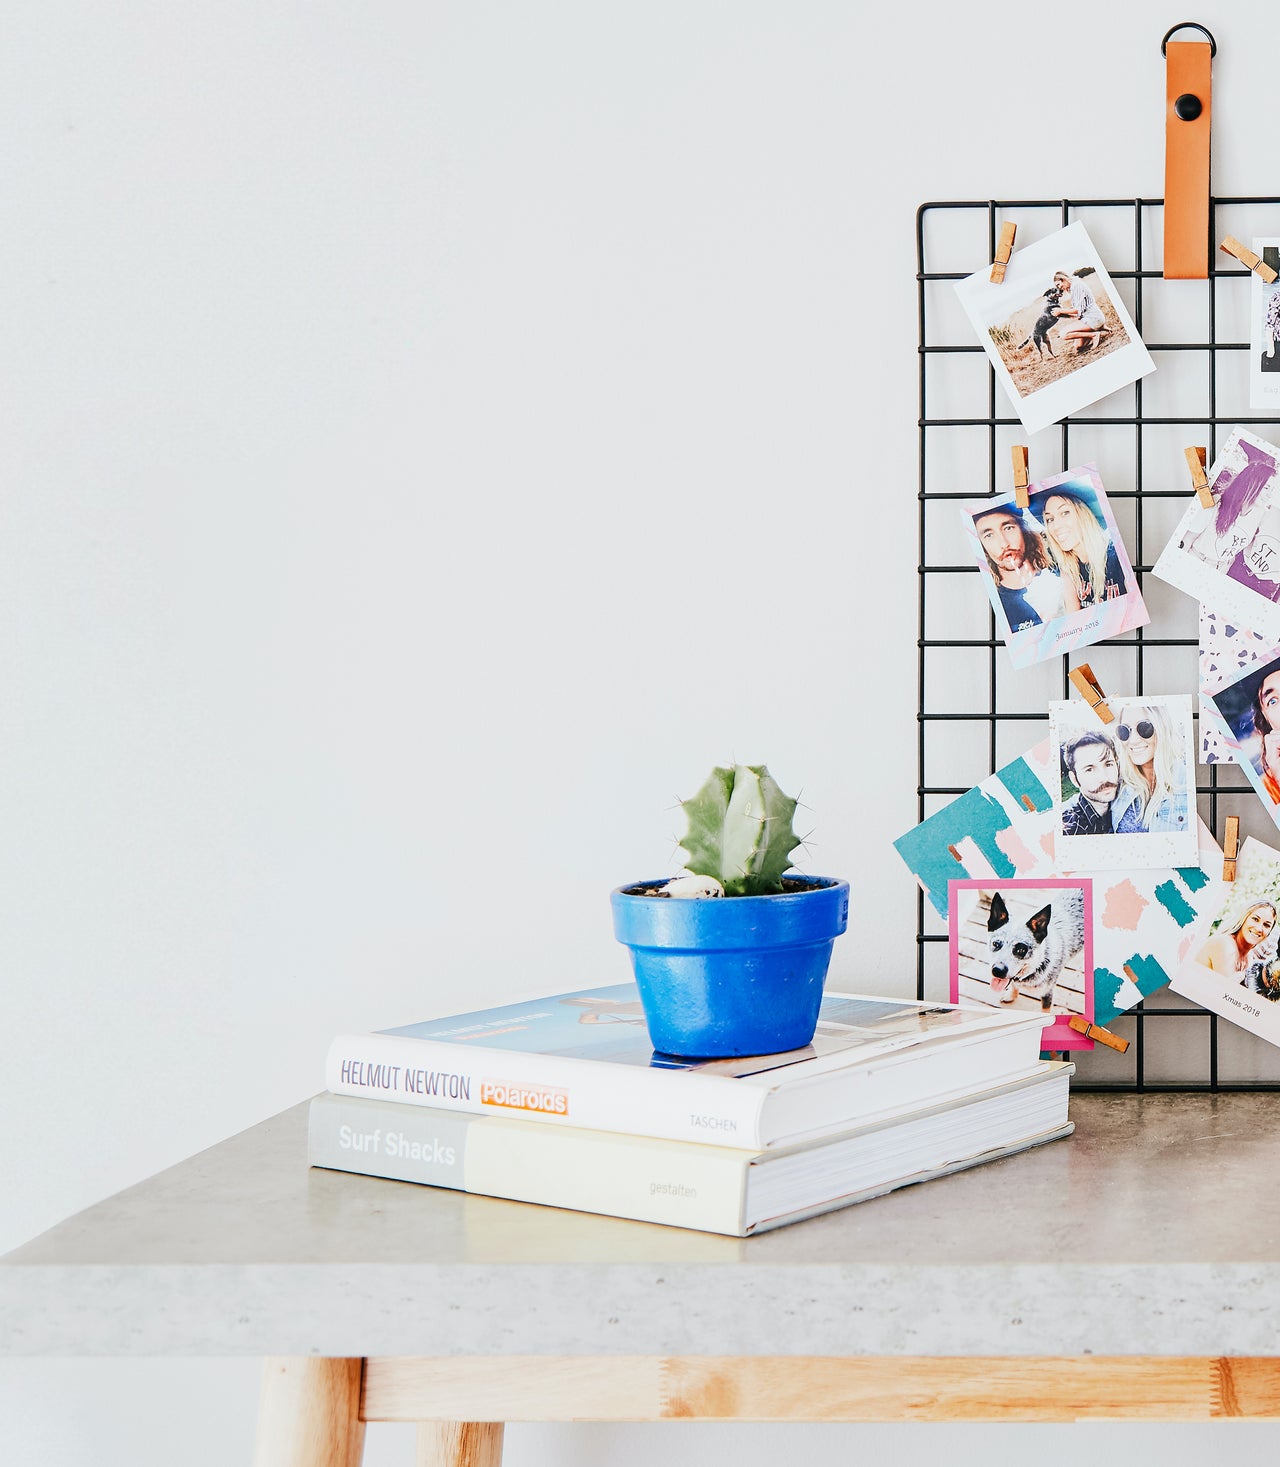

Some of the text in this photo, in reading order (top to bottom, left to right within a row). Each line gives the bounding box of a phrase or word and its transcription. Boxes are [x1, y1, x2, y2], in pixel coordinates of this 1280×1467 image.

[1055, 619, 1100, 641] January 2018
[1223, 993, 1261, 1017] Xmas 2018
[341, 1059, 566, 1113] HELMUT NEWTON Polaroids
[690, 1114, 737, 1132] TASCHEN
[339, 1124, 456, 1166] Surf Shacks
[650, 1182, 697, 1198] gestalten
